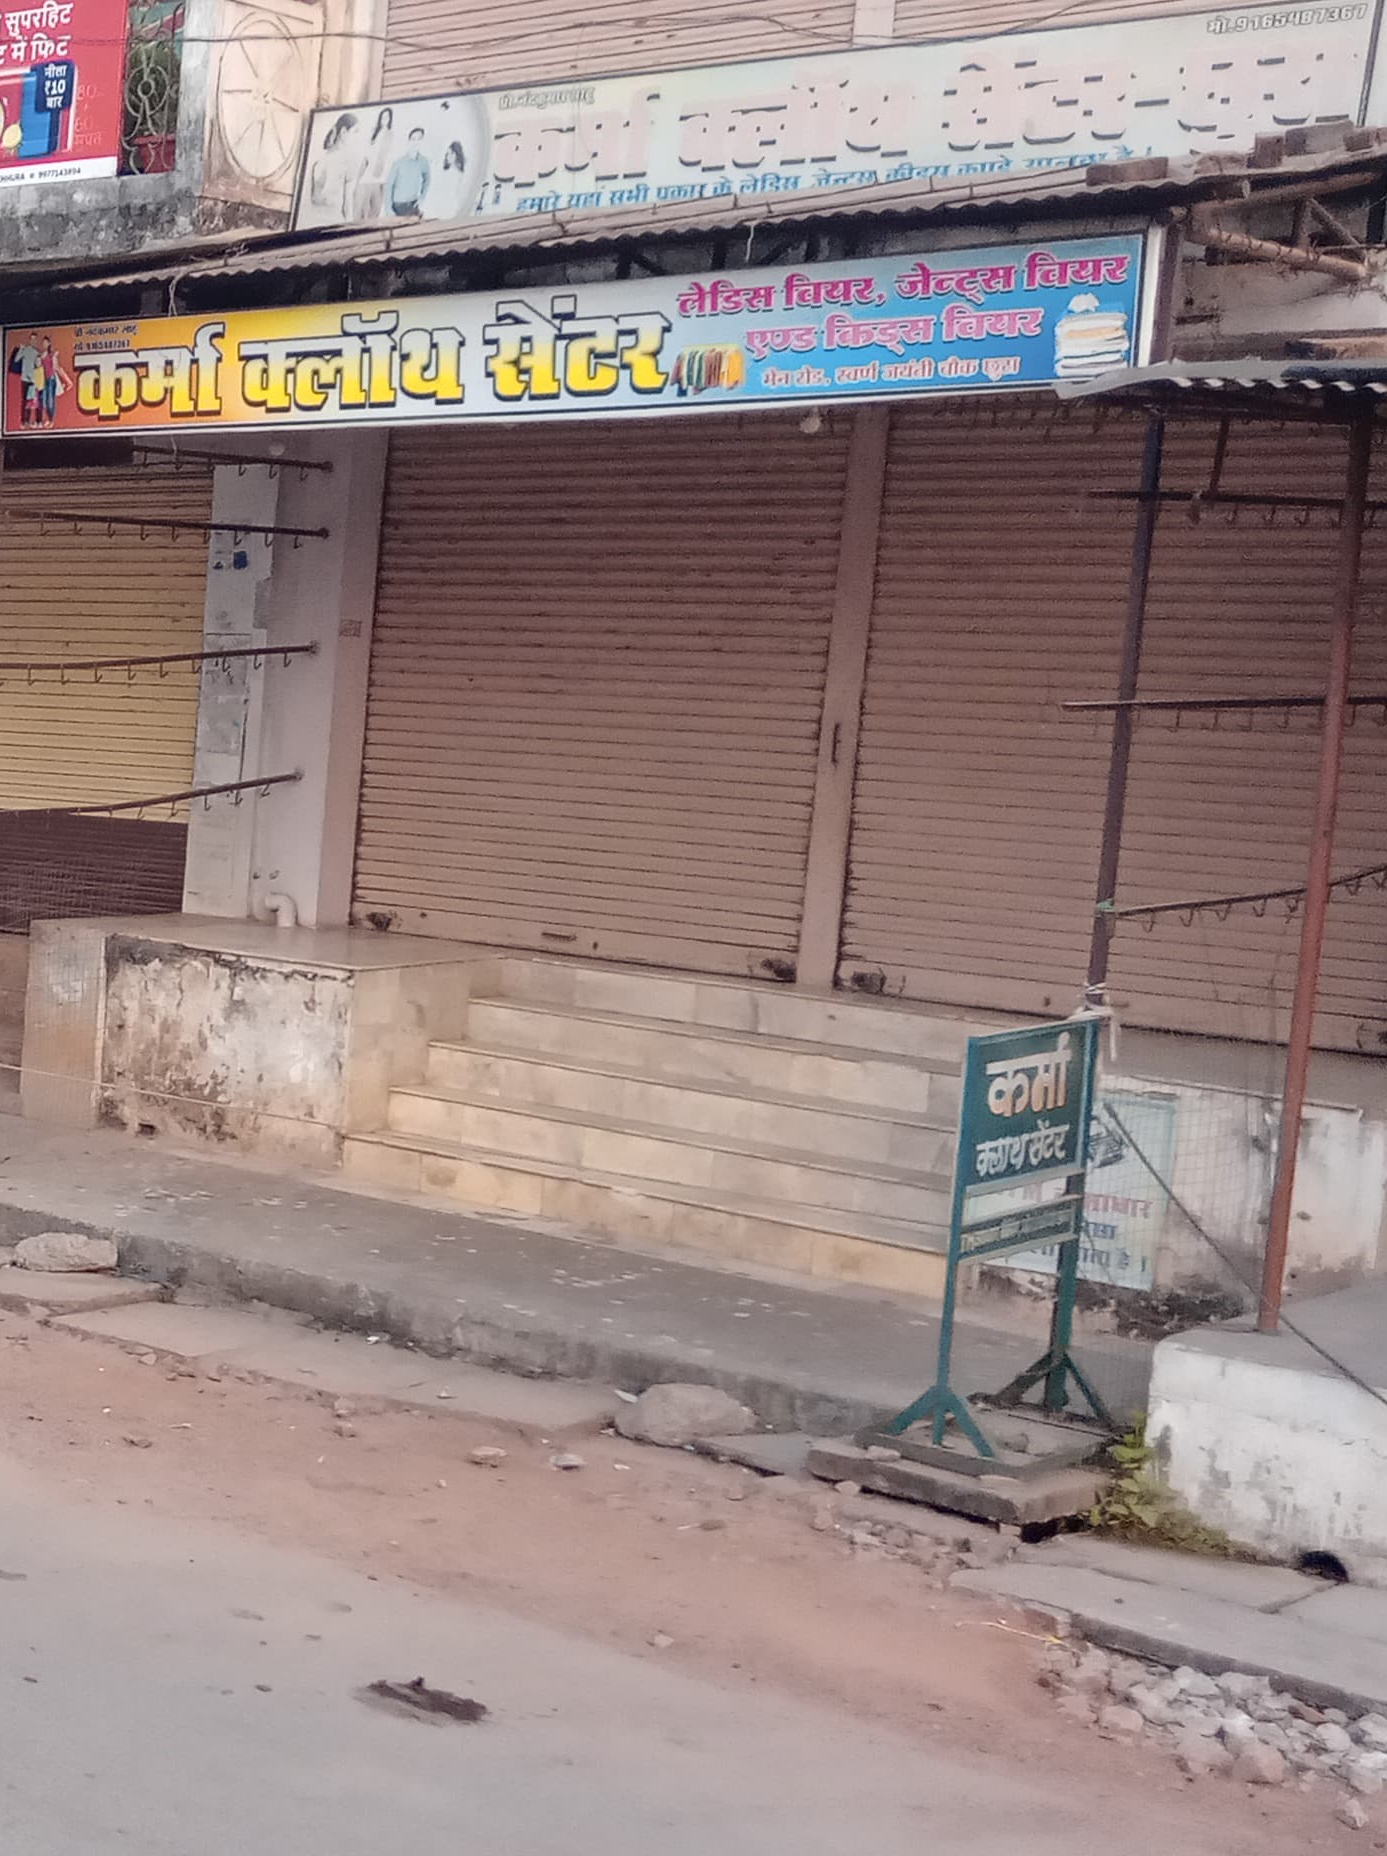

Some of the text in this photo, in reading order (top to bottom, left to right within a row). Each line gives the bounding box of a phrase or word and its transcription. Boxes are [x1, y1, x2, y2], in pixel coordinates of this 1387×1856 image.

[6, 2, 73, 37] सुपरहिट
[12, 36, 29, 62] में
[30, 36, 71, 62] फिट
[677, 250, 1131, 317] लेडिस वियर, जेन्ट्स वियर
[72, 294, 673, 418] कर्मा क्लॉथ सेंटर
[746, 304, 1045, 361] एण्ड किड्स वियर
[986, 1031, 1072, 1117] कर्मा
[1028, 1119, 1070, 1167] सेंटर
